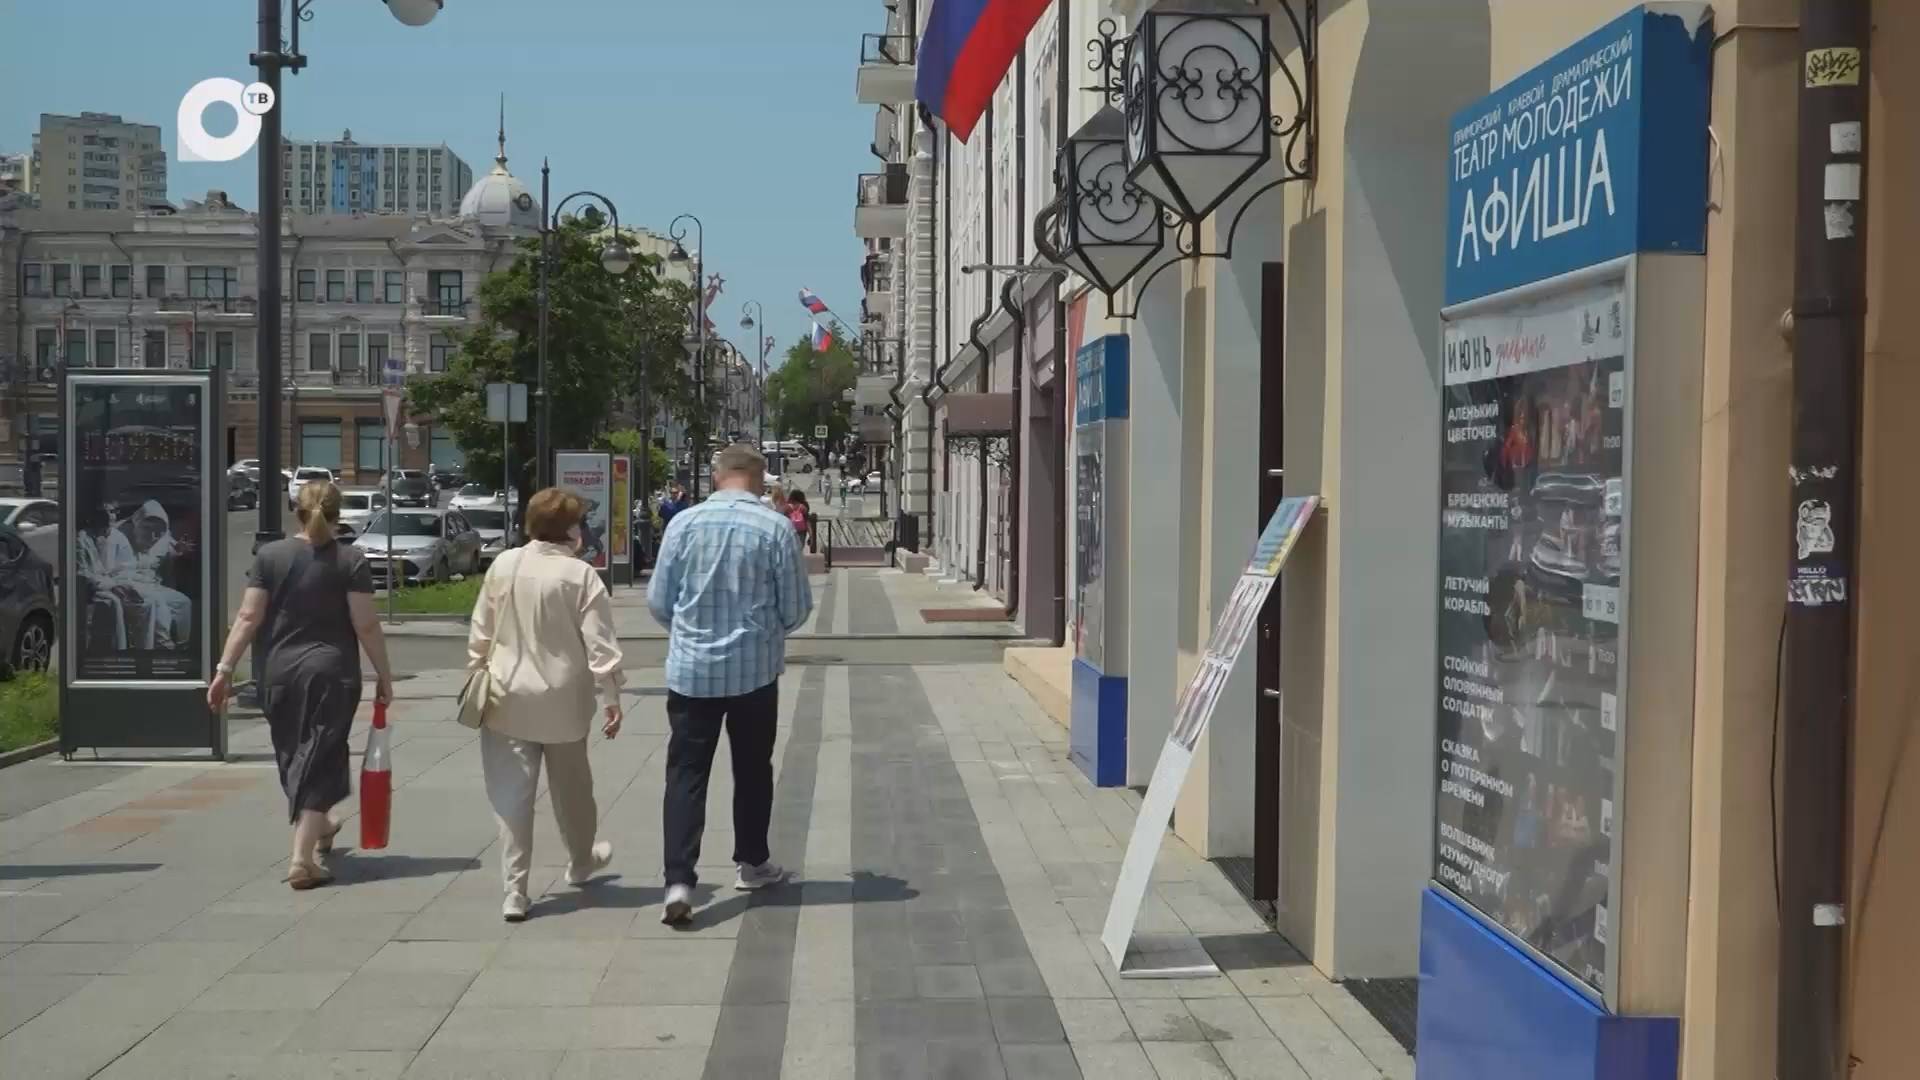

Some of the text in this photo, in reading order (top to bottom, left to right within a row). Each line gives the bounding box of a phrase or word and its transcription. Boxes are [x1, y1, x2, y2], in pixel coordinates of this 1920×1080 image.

[1454, 29, 1634, 145] ПРИМОРСКИЙ КРАЕВОЙ ДРАМАТИЧЕСКИЙ
[1453, 56, 1632, 183] ТЕАТР МОЛОДЕЖИ
[1456, 127, 1616, 269] АФИША
[1448, 335, 1492, 374] ИЮНЬ
[1447, 400, 1499, 422] АЛЕНЬКИЙ
[1447, 425, 1497, 444] ЦВЕТОЧЕК
[1447, 493, 1509, 510] БРЕМЕНСКИЕ
[1447, 511, 1509, 530] МУЗЫКАНТЫ
[1797, 566, 1827, 575] HELLO
[1444, 575, 1489, 594] ЛЕТУЧИЙ
[1444, 597, 1491, 616] КОРАБЛЬ
[1444, 655, 1489, 678] СТОЙКИЙ
[1443, 675, 1504, 705] ОЛОВЯННЫЙ
[1442, 697, 1495, 724] СОЛДАТИК
[1442, 738, 1480, 763] СКАЗКА
[1441, 759, 1514, 799] О ПОТЕРЯННОМ
[1442, 779, 1485, 808] ВРЕМЕНИ
[1440, 821, 1496, 863] ВОЛШЕБНИК
[1440, 862, 1473, 894] ГОРОДА
